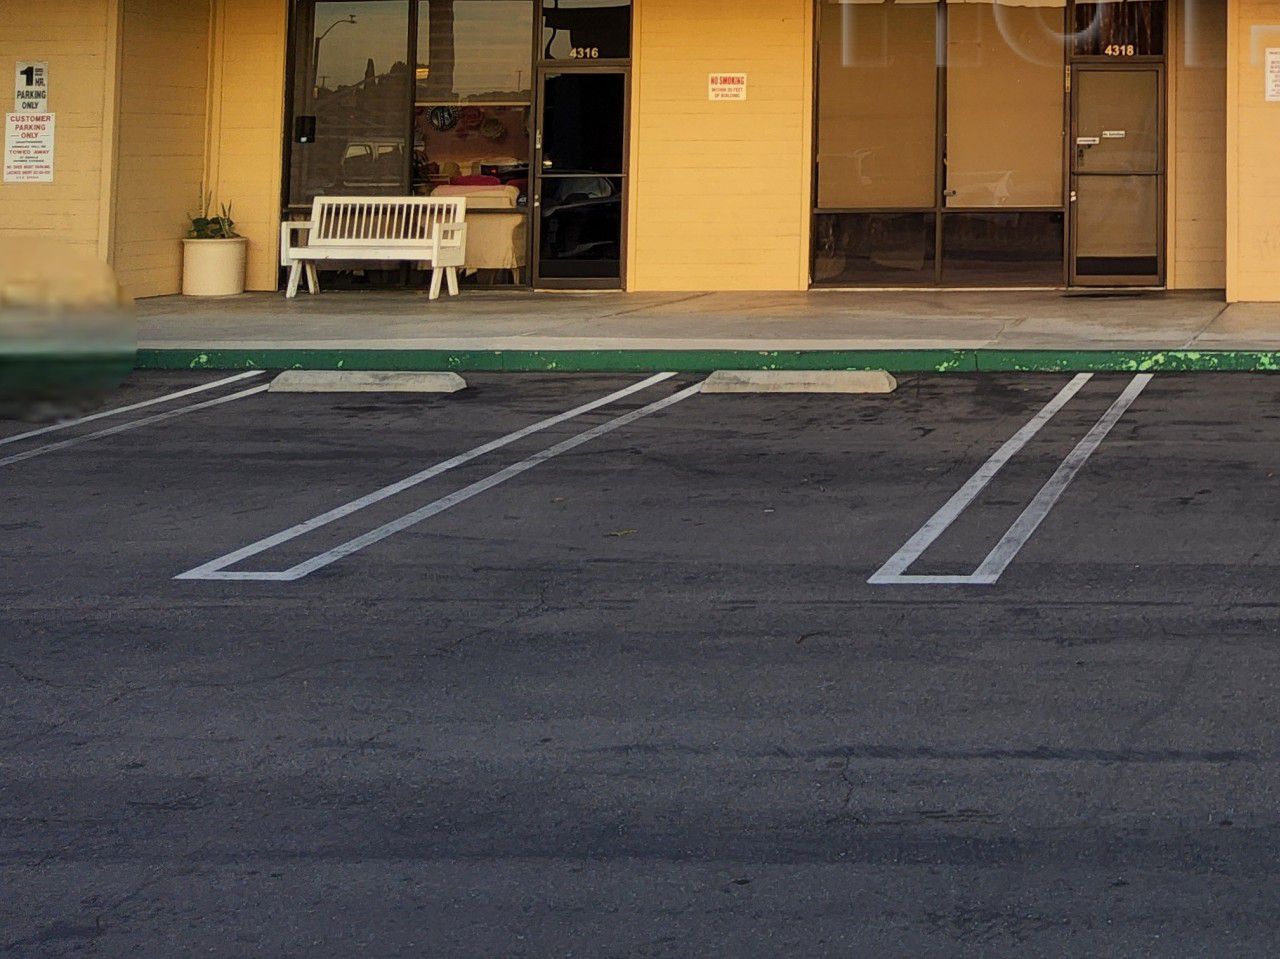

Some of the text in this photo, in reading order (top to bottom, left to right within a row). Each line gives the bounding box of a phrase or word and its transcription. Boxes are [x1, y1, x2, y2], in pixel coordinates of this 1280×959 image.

[569, 47, 599, 58] 4316
[1104, 44, 1135, 56] 4318
[20, 66, 34, 86] 1
[719, 76, 745, 85] SMOKING
[16, 90, 47, 100] PARKING
[21, 101, 40, 110] ONLY
